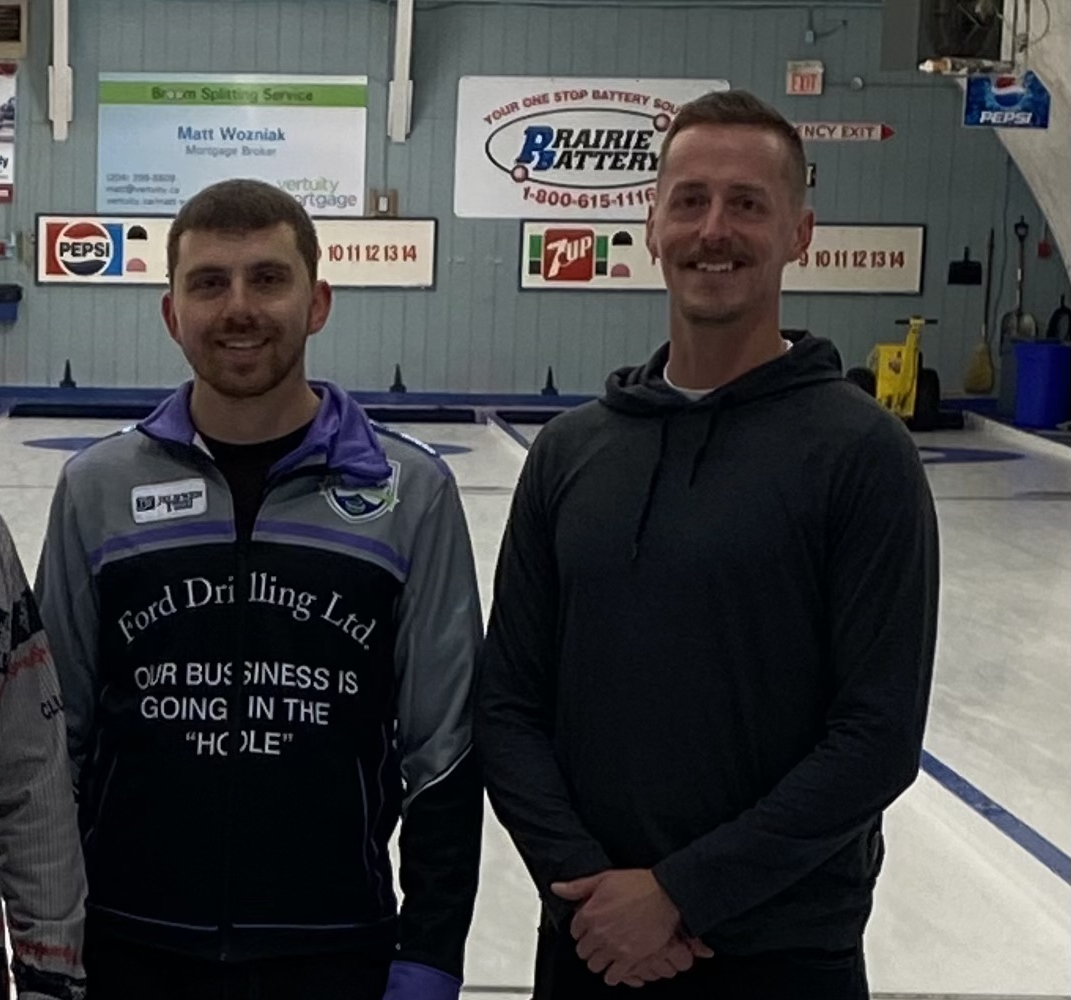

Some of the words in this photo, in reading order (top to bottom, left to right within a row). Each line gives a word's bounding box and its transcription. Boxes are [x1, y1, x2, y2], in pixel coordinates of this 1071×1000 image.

[201, 87, 259, 104] Splitting
[262, 87, 313, 101] Service
[483, 101, 520, 125] YOUR
[522, 93, 549, 108] ONE
[553, 89, 589, 103] STOP
[592, 89, 651, 105] BATTERY
[653, 98, 680, 115] SOU
[979, 110, 1033, 125] PEPSI
[177, 126, 214, 141] Matt
[218, 126, 286, 141] Wozniak
[840, 126, 876, 139] EXIT
[185, 145, 238, 158] Mortgage
[241, 145, 277, 157] Broker
[515, 125, 654, 165] PRAIRIE
[277, 176, 339, 193] vertuity
[292, 193, 357, 209] ortgage
[60, 241, 110, 258] PEPSI
[328, 244, 343, 262] 10
[346, 244, 360, 262] 11
[365, 244, 380, 262] 12
[384, 245, 398, 262] 13
[402, 245, 417, 262] 14
[546, 235, 592, 278] 7UP
[815, 250, 830, 267] 10
[834, 250, 848, 268] 11
[851, 250, 867, 268] 12
[870, 251, 886, 268] 13
[889, 251, 905, 269] 14
[117, 584, 178, 645] Ford
[320, 590, 377, 651] Ltd.
[133, 661, 178, 691] OUR
[337, 669, 359, 695] IS
[139, 695, 228, 721] GOING
[247, 695, 275, 721] IN
[282, 697, 331, 726] THE
